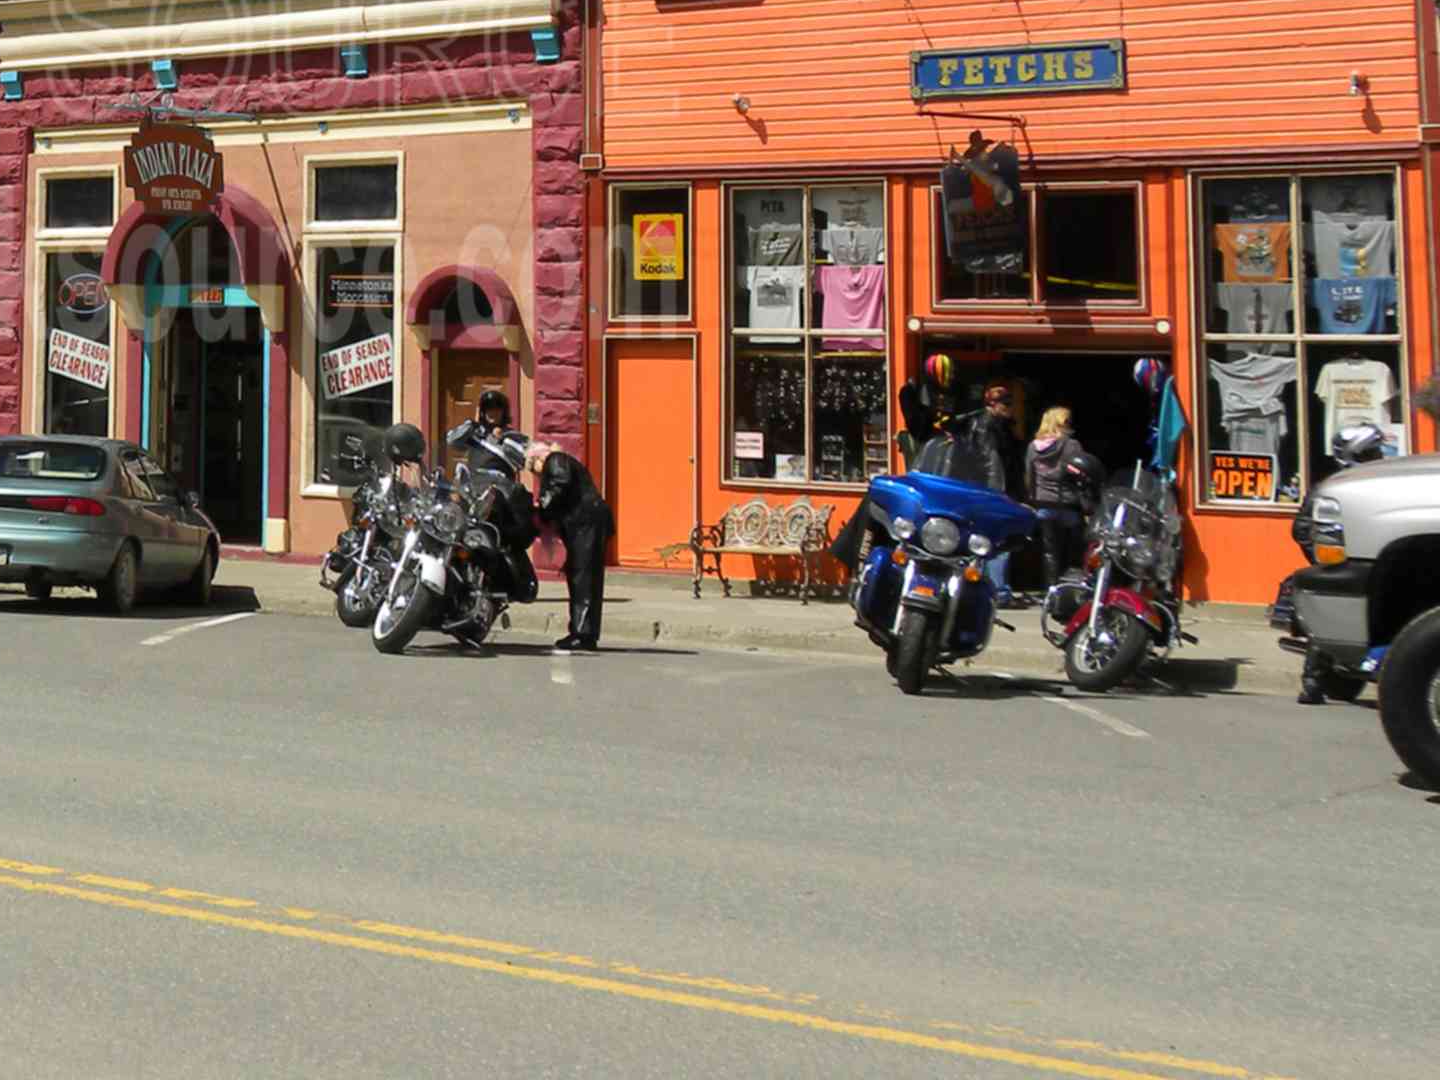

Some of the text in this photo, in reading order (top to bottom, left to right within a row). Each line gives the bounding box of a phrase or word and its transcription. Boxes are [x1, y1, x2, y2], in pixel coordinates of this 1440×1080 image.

[937, 50, 1096, 87] FETCHS
[132, 141, 215, 190] INDIAN PLAZA
[640, 263, 677, 274] Kodak
[59, 279, 110, 306] OPEN
[330, 279, 394, 291] Minnetonka
[336, 291, 389, 304] Moccasins
[52, 332, 109, 363] END OF SEASON
[321, 337, 390, 372] END OF SEASON
[49, 349, 106, 385] CLEARANCE
[326, 356, 393, 394] CLEARANCE
[1215, 455, 1236, 468] YES
[1212, 469, 1273, 498] OPEN
